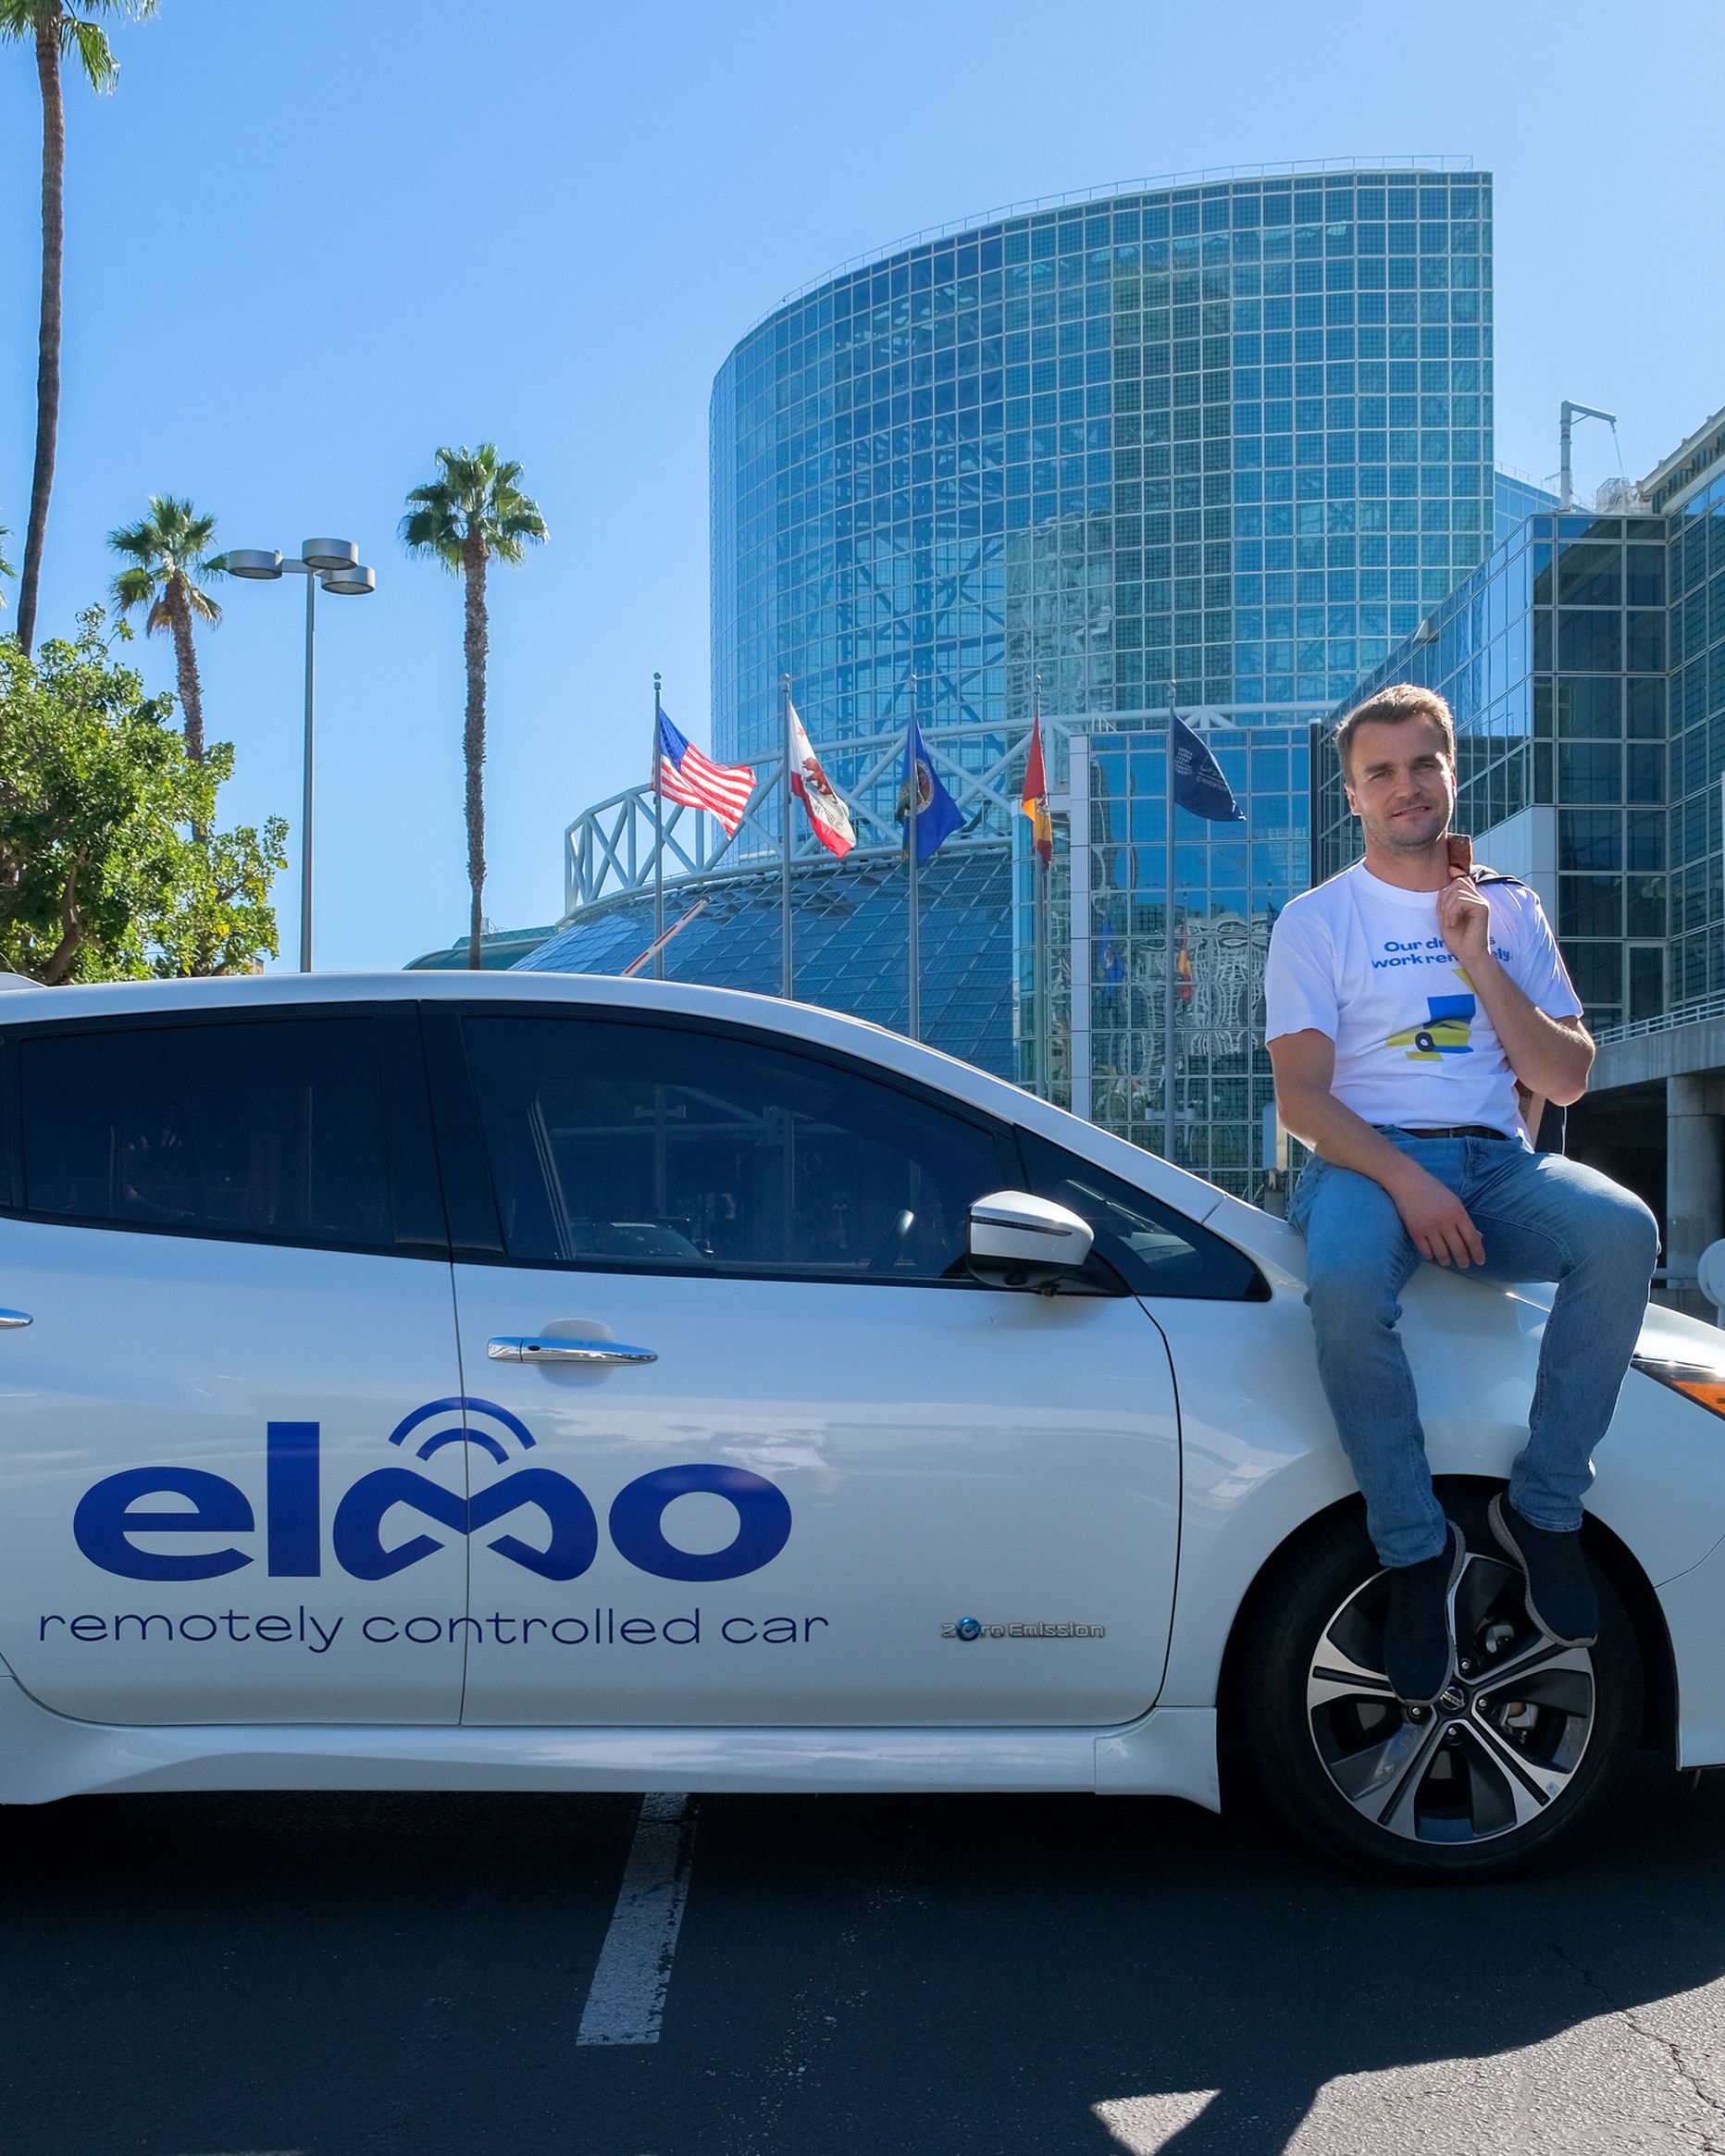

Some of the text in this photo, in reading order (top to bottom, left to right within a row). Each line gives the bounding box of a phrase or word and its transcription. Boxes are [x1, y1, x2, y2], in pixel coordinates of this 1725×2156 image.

[1384, 940, 1422, 952] Our
[1371, 953, 1422, 969] work
[73, 1421, 792, 1582] elmo
[40, 1605, 829, 1654] remotely controlled car
[1009, 1622, 1106, 1638] Emission
